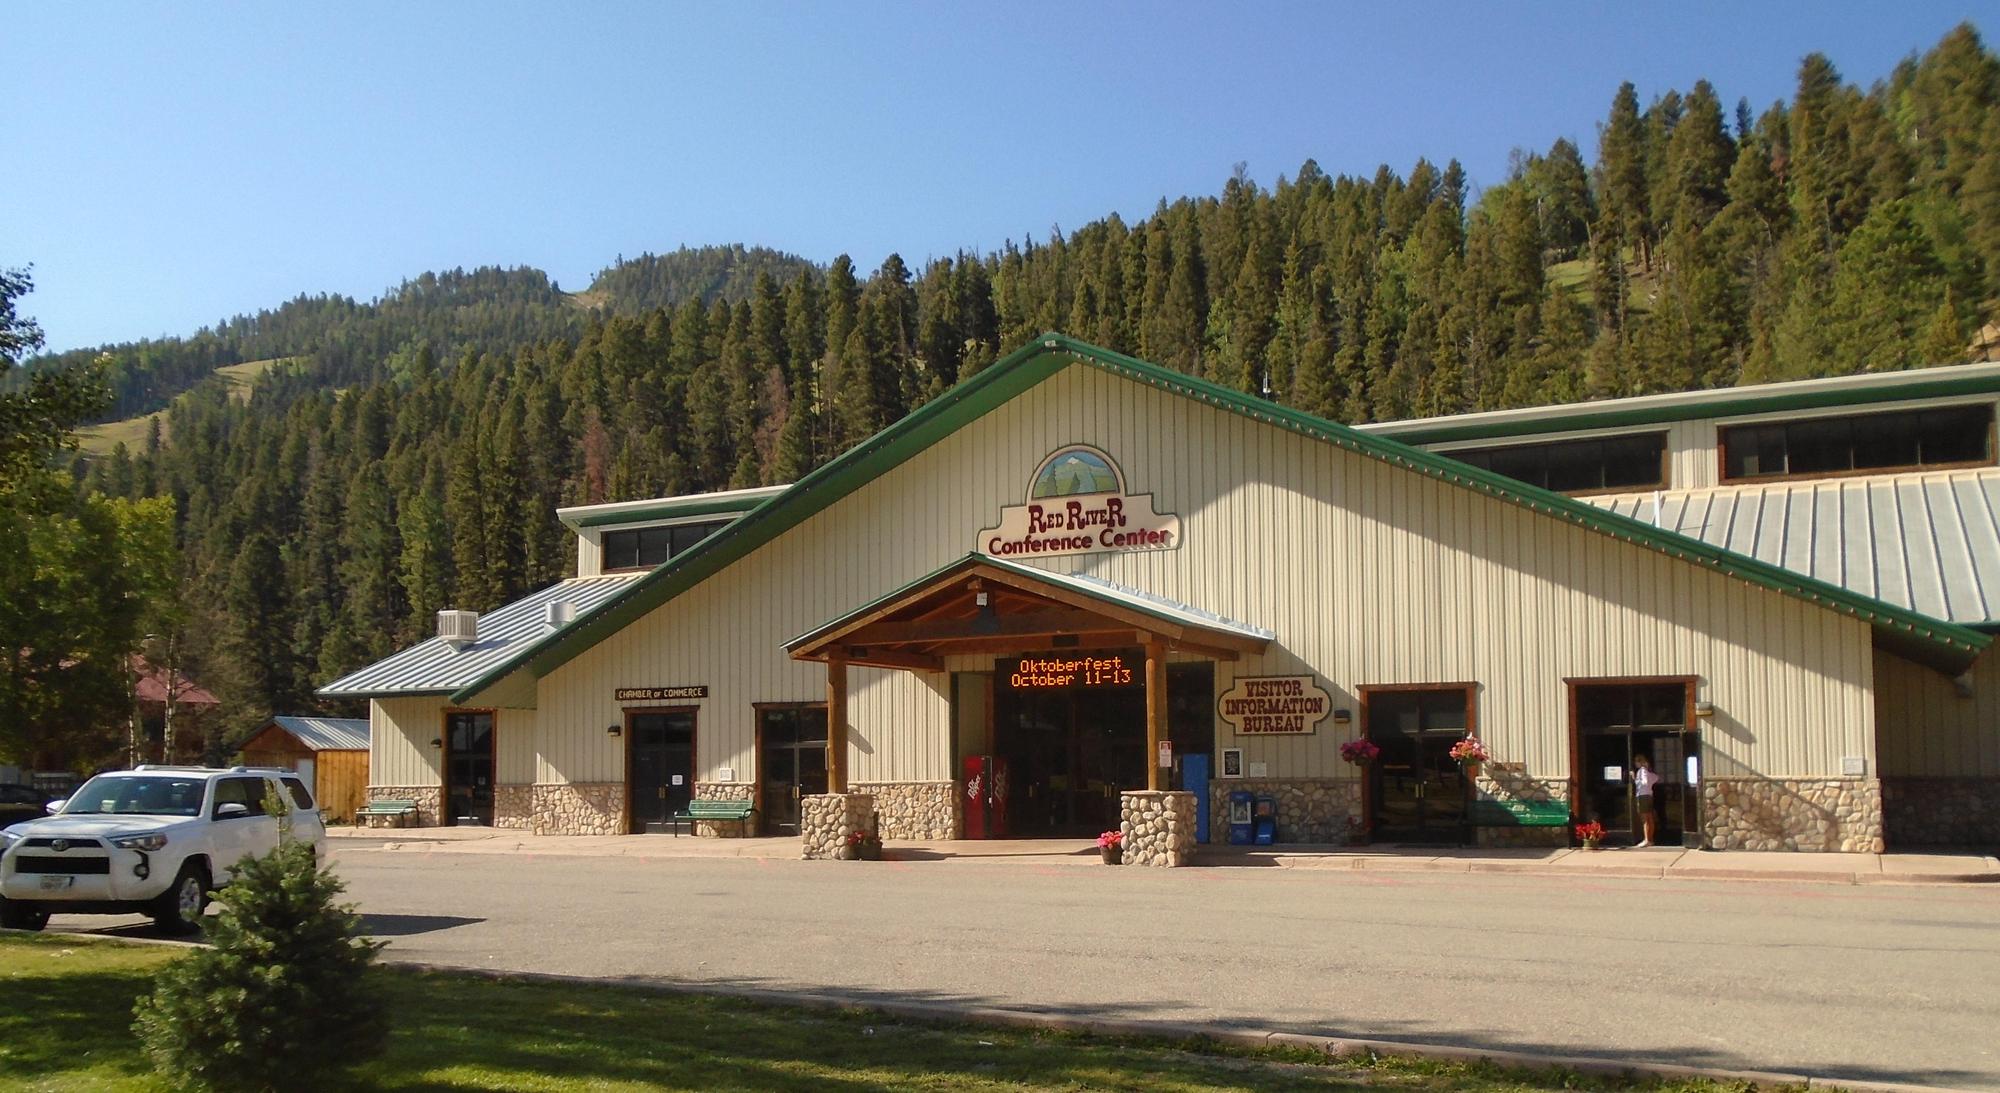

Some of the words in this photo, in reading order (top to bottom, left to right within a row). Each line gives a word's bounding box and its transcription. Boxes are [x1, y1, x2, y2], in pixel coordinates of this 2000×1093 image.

[988, 534, 1092, 556] Conference
[1099, 528, 1168, 548] Center
[1020, 657, 1121, 673] Oktoberfest
[1011, 672, 1075, 687] October
[1085, 669, 1131, 685] 11-13
[618, 689, 652, 698] CHAMBER
[663, 687, 702, 697] COMMERCE
[1245, 680, 1303, 697] VISITOR
[1225, 697, 1323, 715] INFORMATION
[1243, 715, 1304, 732] BUREAU
